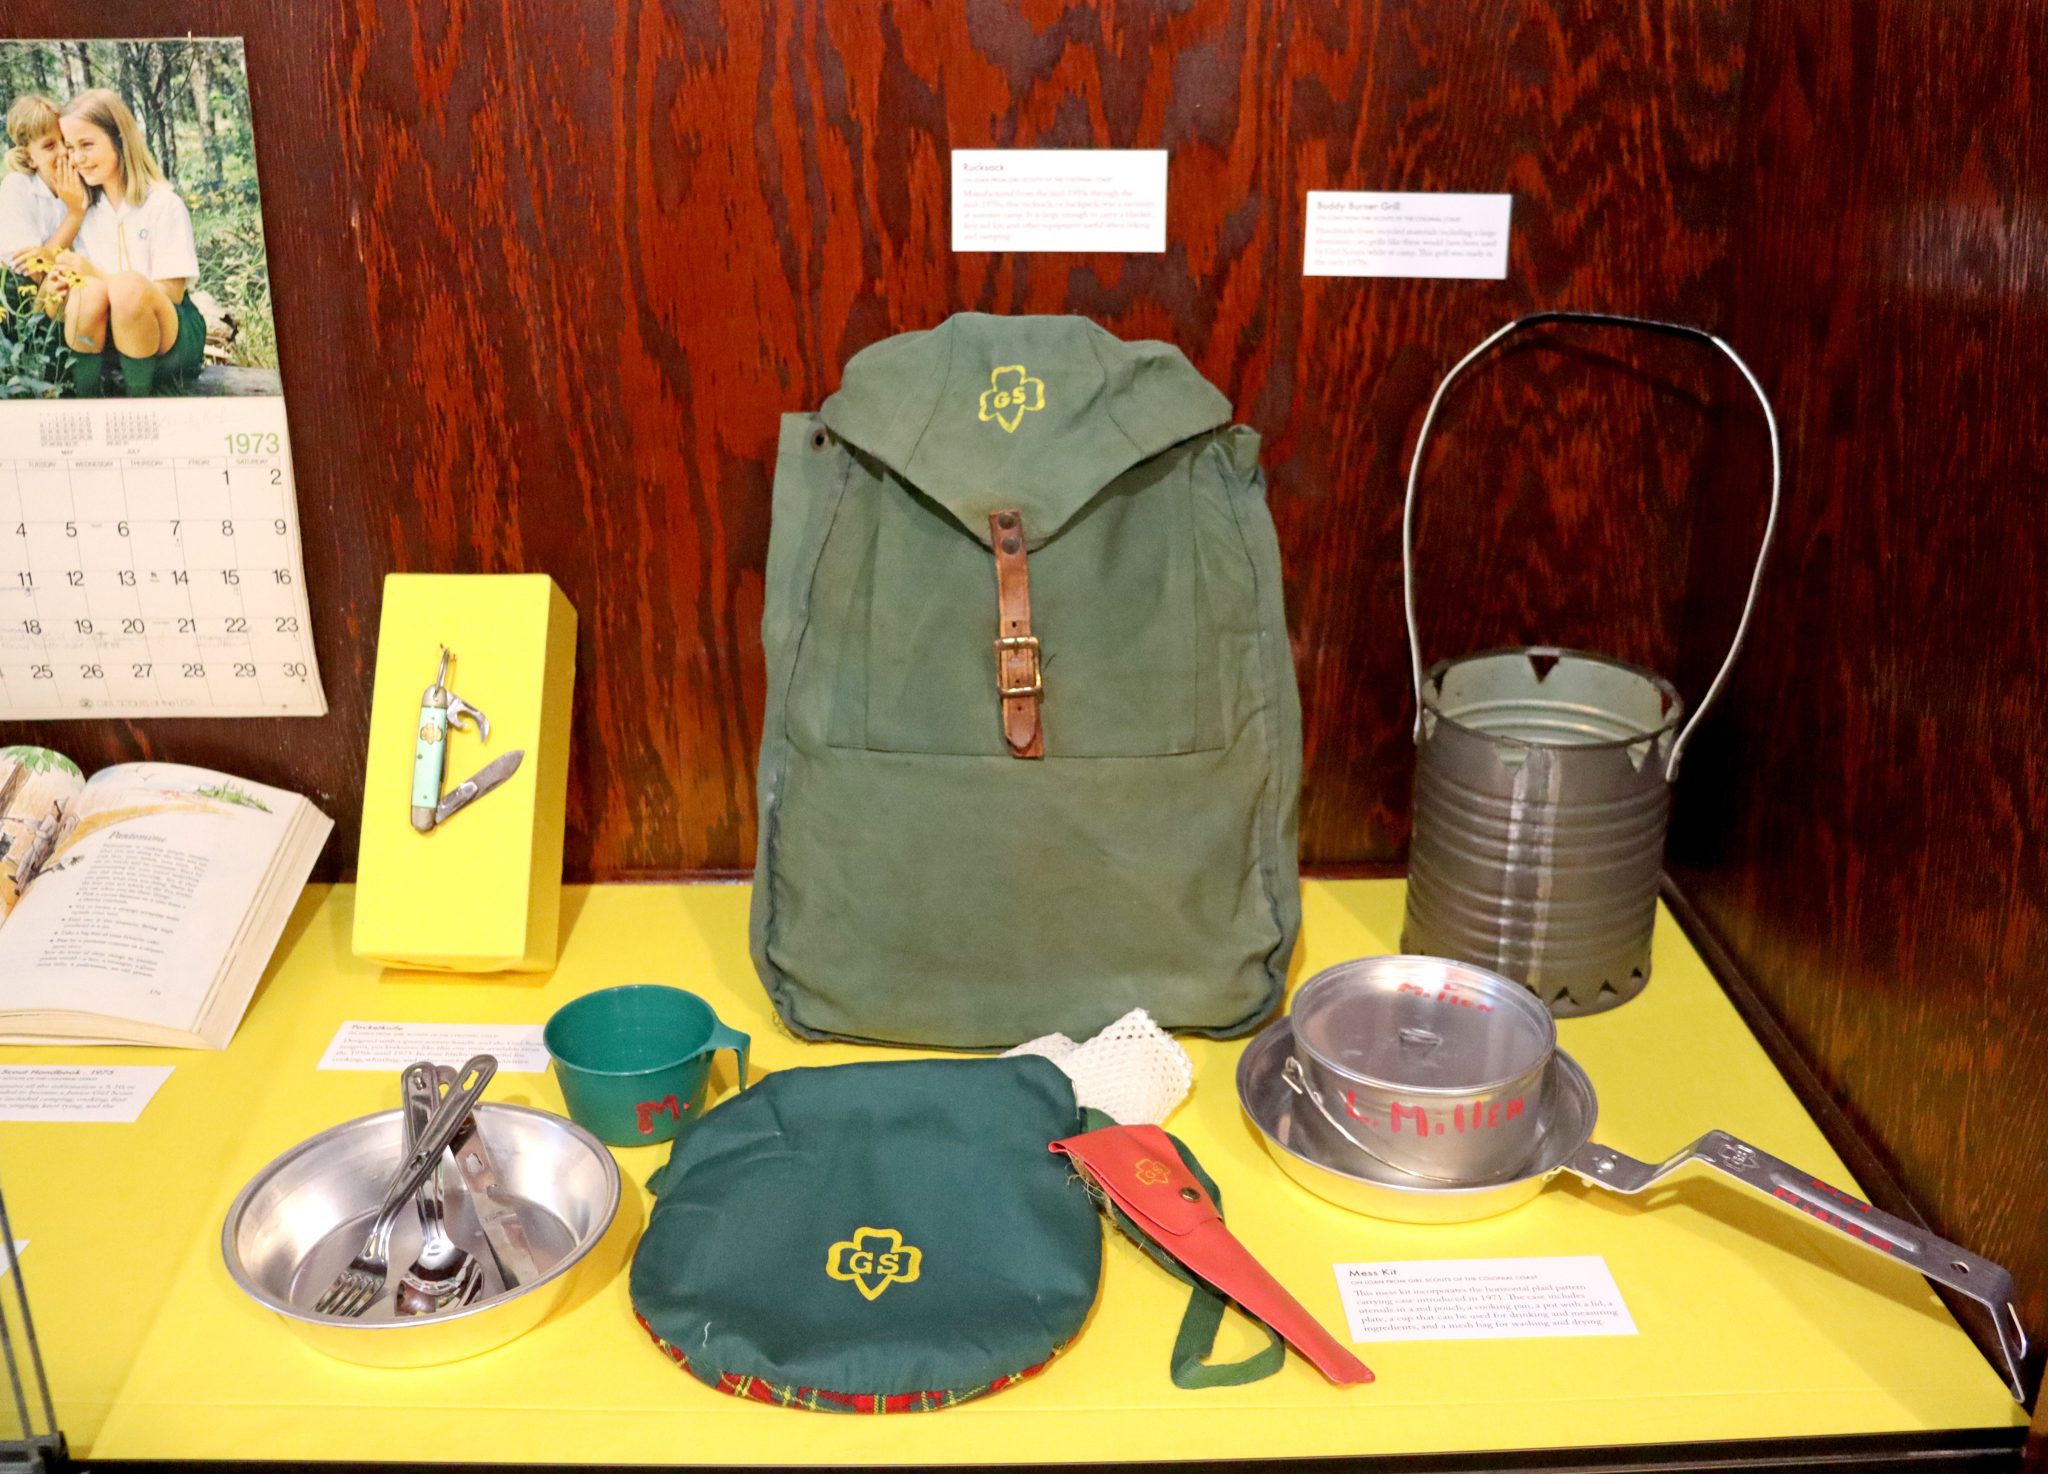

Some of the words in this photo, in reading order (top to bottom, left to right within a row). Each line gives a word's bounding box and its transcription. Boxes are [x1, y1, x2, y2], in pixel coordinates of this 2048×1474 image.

[963, 162, 1004, 171] Rucksack
[1317, 201, 1345, 211] Buddy
[1348, 201, 1378, 210] Burner
[1380, 202, 1400, 210] Grill
[994, 387, 1026, 409] GS
[225, 433, 280, 454] 1973
[222, 469, 229, 485] 1
[270, 468, 282, 485] 2
[16, 522, 27, 538] 4
[66, 521, 77, 537] 5
[117, 520, 130, 537] 6
[170, 520, 181, 536] 7
[222, 520, 234, 536] 8
[274, 519, 287, 535] 9
[18, 572, 33, 587] 11
[66, 571, 85, 586] 12
[117, 570, 136, 586] 13
[172, 570, 189, 585] 14
[221, 569, 240, 585] 15
[273, 568, 291, 585] 16
[22, 619, 42, 635] 18
[74, 619, 93, 634] 19
[121, 618, 145, 634] 20
[177, 618, 196, 633] 21
[224, 617, 247, 633] 22
[275, 617, 299, 633] 23
[30, 664, 53, 679] 25
[80, 664, 104, 679] 26
[132, 663, 152, 679] 27
[181, 663, 206, 678] 28
[233, 663, 257, 678] 29
[283, 662, 307, 678] 30
[635, 1094, 690, 1134] M.
[849, 1251, 899, 1274] GS
[1349, 1269, 1379, 1277] Mess
[1381, 1268, 1397, 1276] Kit
[1413, 1288, 1467, 1296] incorporates
[1531, 1284, 1553, 1292] plaid
[1417, 1295, 1466, 1303] introduced
[1506, 1292, 1524, 1300] The
[1548, 1292, 1585, 1300] includes
[1509, 1311, 1550, 1319] drinking
[1551, 1309, 1569, 1317] and
[1475, 1320, 1493, 1329] bag
[1511, 1319, 1550, 1328] washing
[1552, 1318, 1569, 1326] and
